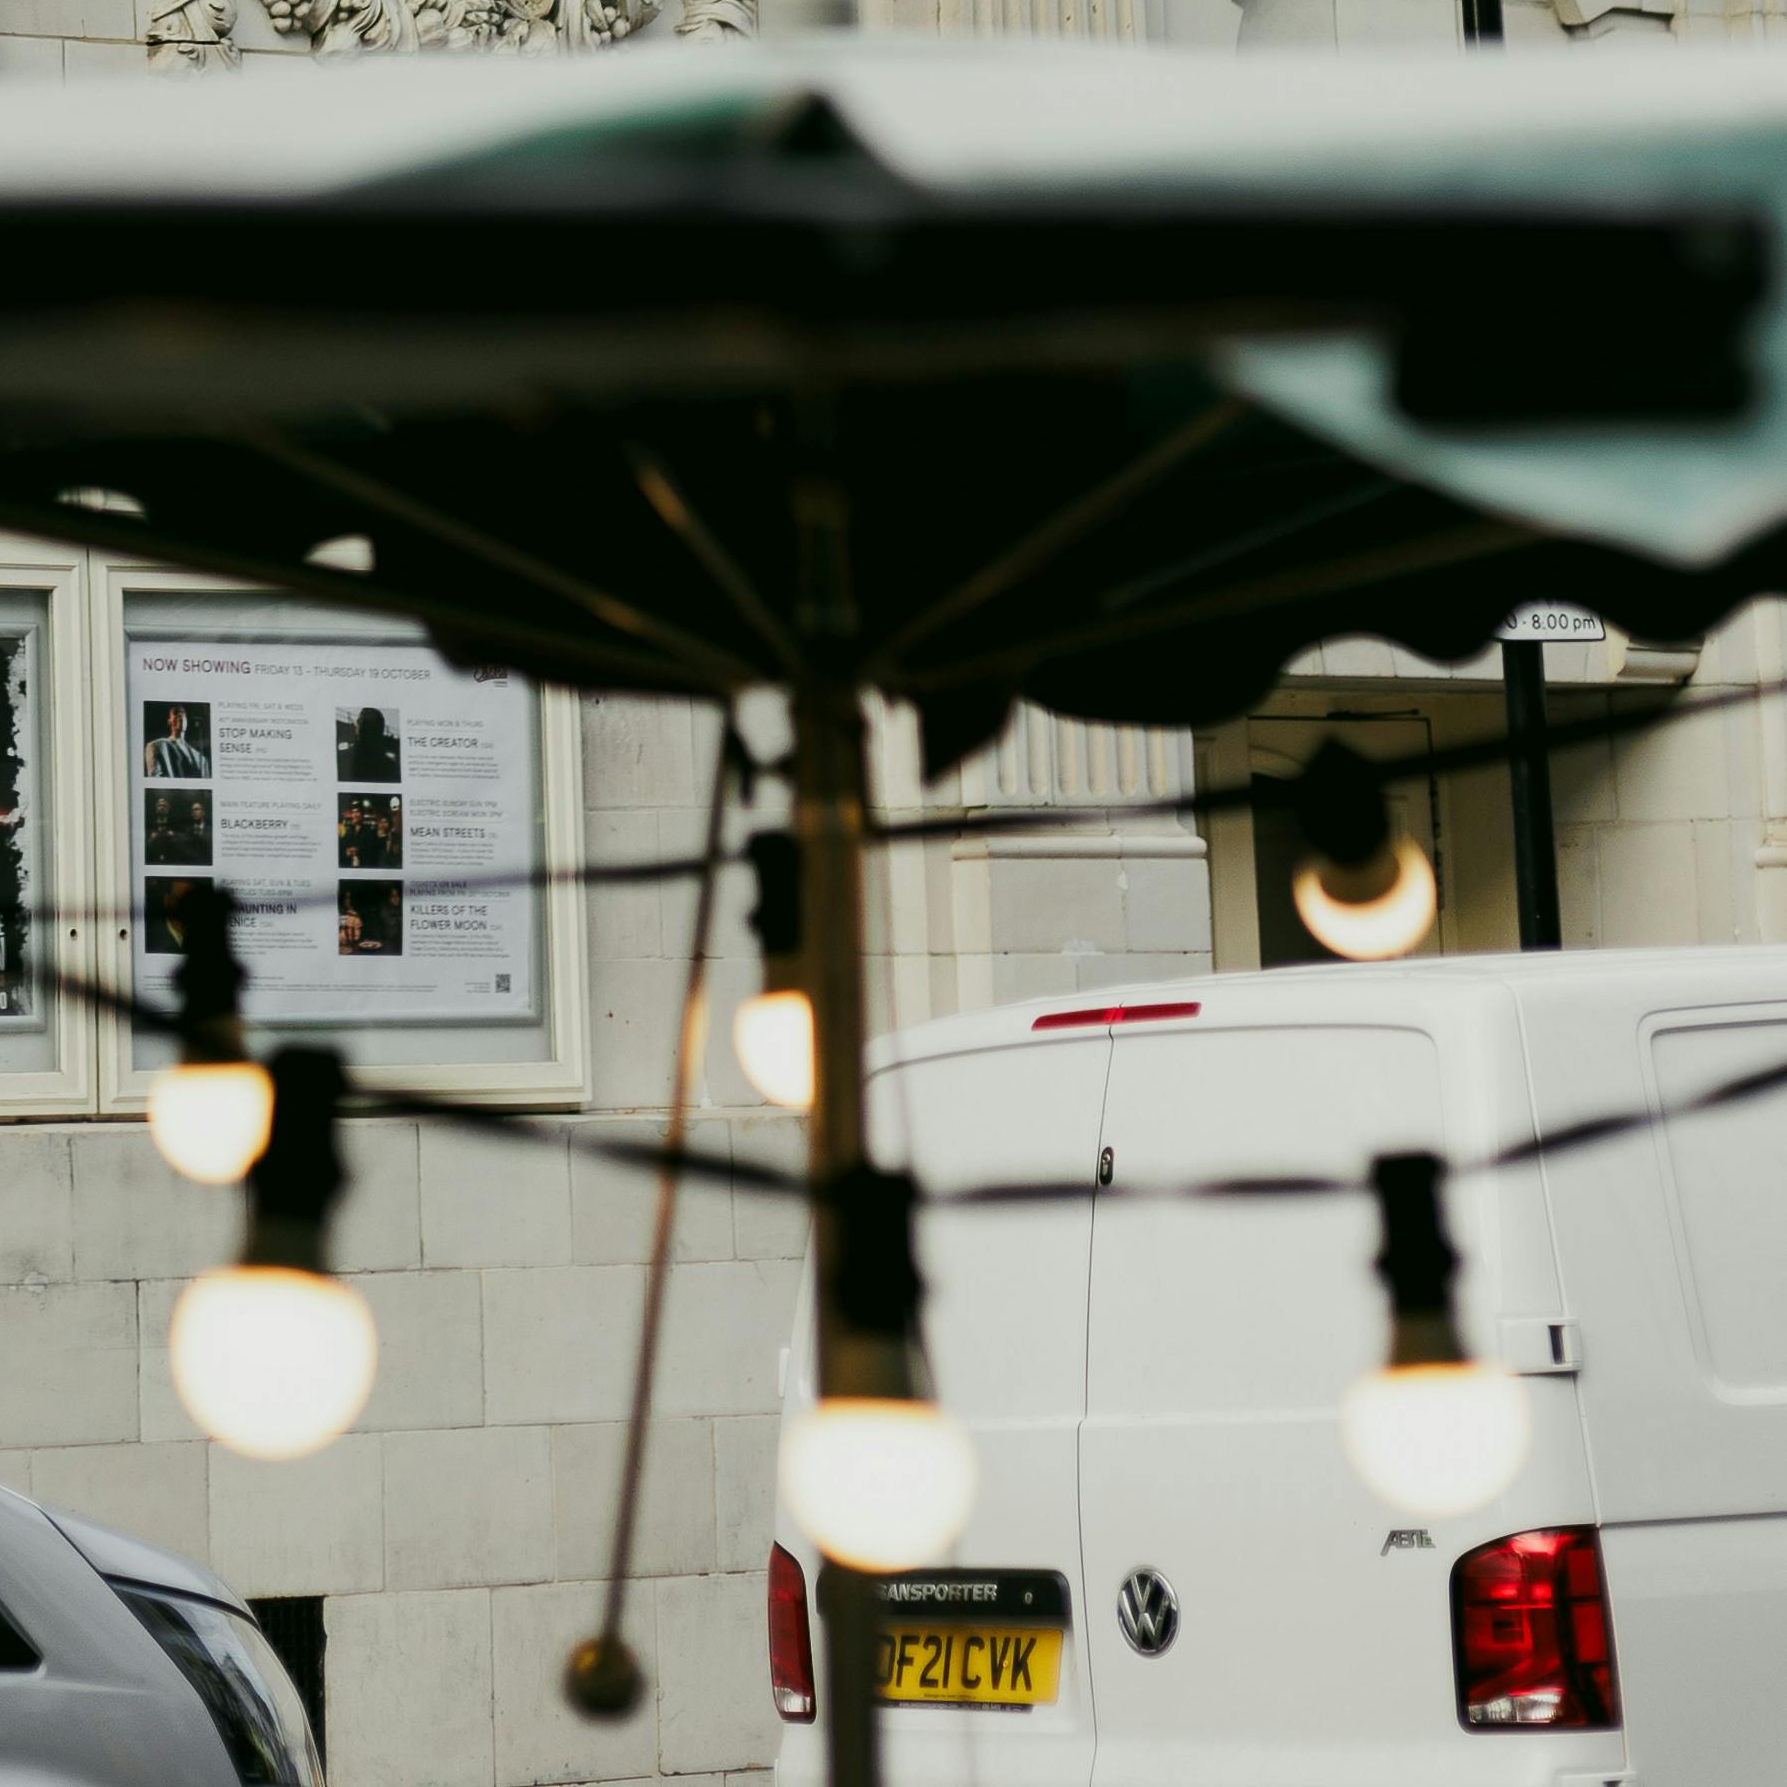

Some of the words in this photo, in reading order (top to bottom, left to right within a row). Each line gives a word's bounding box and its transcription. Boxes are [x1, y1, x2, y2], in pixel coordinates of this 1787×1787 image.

[1573, 616, 1596, 632] pm
[143, 658, 178, 673] NOW
[182, 659, 251, 675] SHOWING
[255, 664, 290, 676] FRIDAY
[314, 666, 365, 678] THURSDAY
[381, 668, 431, 680] OCTOBER
[219, 727, 247, 739] STOP
[249, 728, 292, 740] MAKING
[219, 742, 252, 754] SENSE
[407, 735, 427, 747] THE
[430, 737, 478, 749] CREATOR
[220, 818, 289, 830] BLACKBERRY
[410, 826, 440, 838] MEAN
[443, 827, 486, 839] STREETS
[286, 903, 297, 914] IN
[410, 905, 449, 916] KILLERS
[451, 905, 467, 916] OF
[468, 906, 488, 917] THE
[229, 917, 257, 928] ENICE
[410, 919, 451, 930] FLOWER
[454, 919, 487, 931] MOON
[961, 1635, 1038, 1692] CVK
